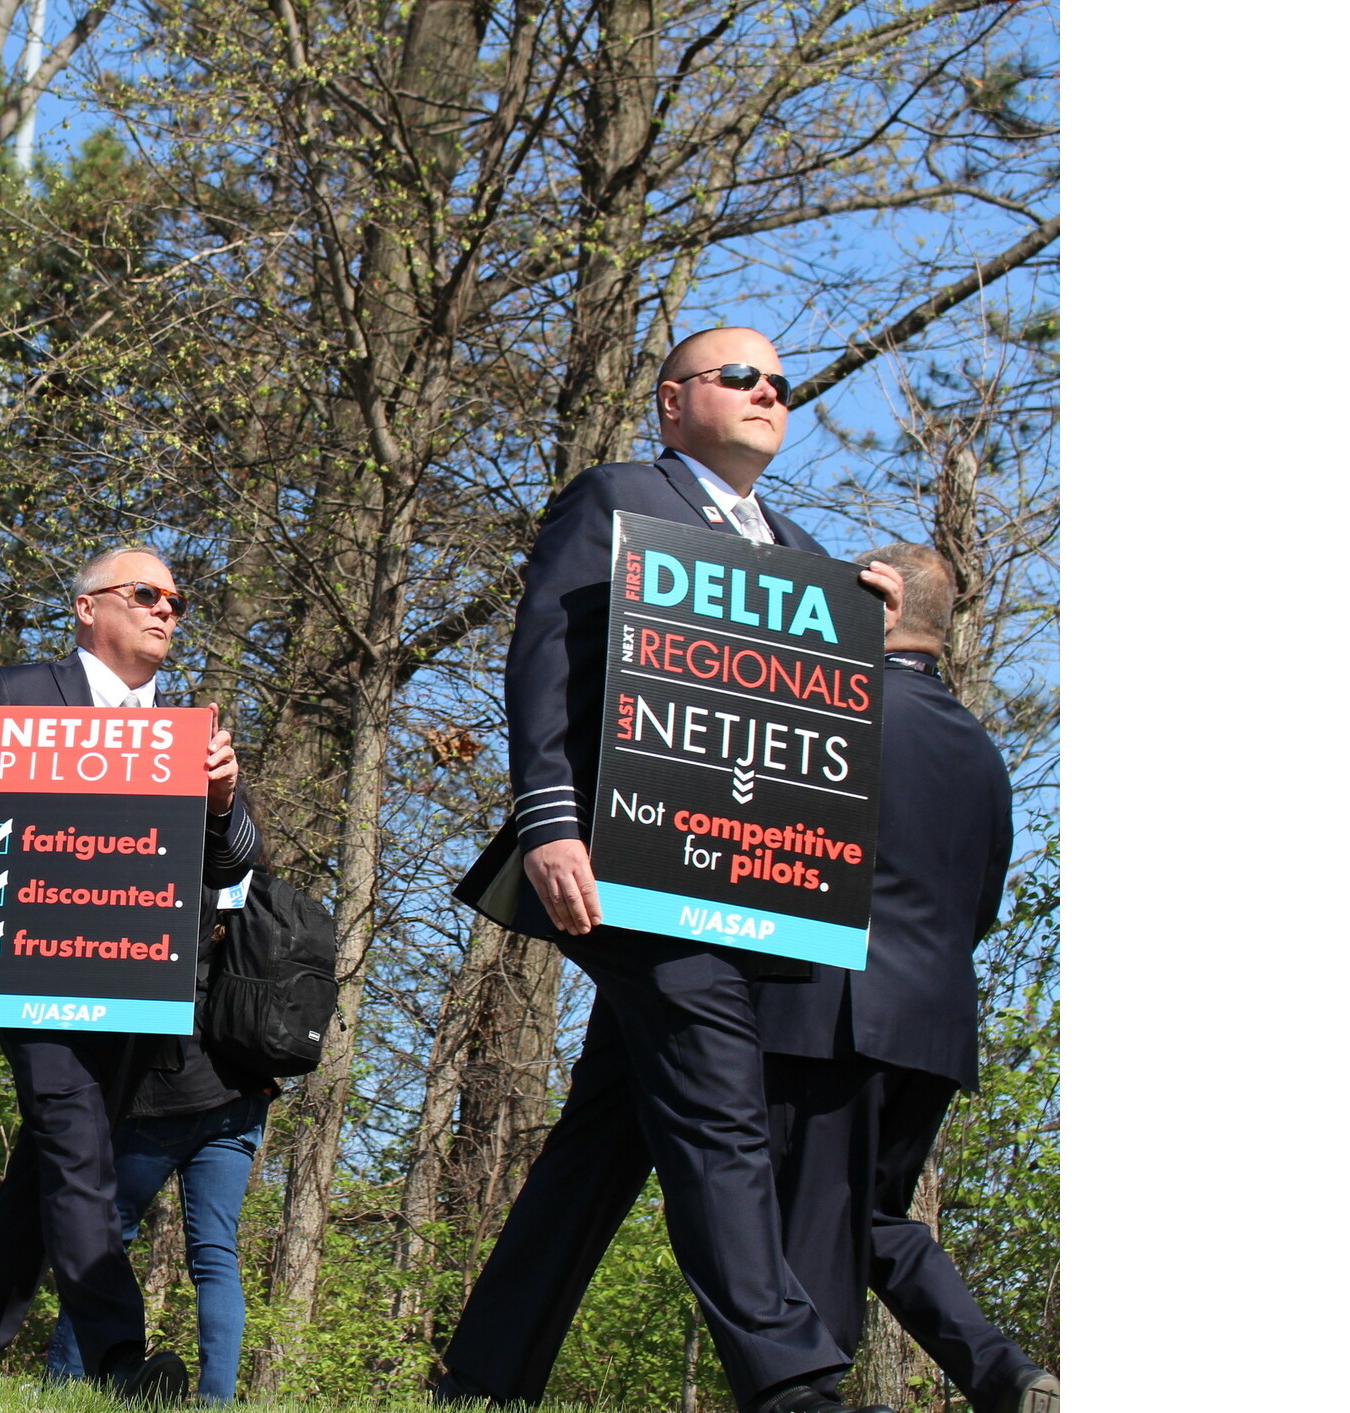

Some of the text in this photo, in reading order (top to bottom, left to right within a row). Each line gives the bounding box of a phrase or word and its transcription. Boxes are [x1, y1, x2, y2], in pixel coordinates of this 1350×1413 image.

[625, 551, 642, 601] FIRST
[643, 549, 839, 644] DELTA
[622, 624, 634, 663] NEXT
[639, 628, 870, 713] REGIONALS
[1, 717, 174, 750] NETJETS
[617, 693, 635, 740] LAST
[634, 694, 849, 782] NETJETS
[21, 825, 167, 861] fatigued.
[611, 788, 863, 865] Not competitive
[684, 834, 830, 893] for pilots.
[17, 879, 184, 909] discounted.
[679, 905, 775, 940] NJASAP
[13, 930, 179, 962] frustrated.
[21, 1002, 107, 1024] NJASAP
